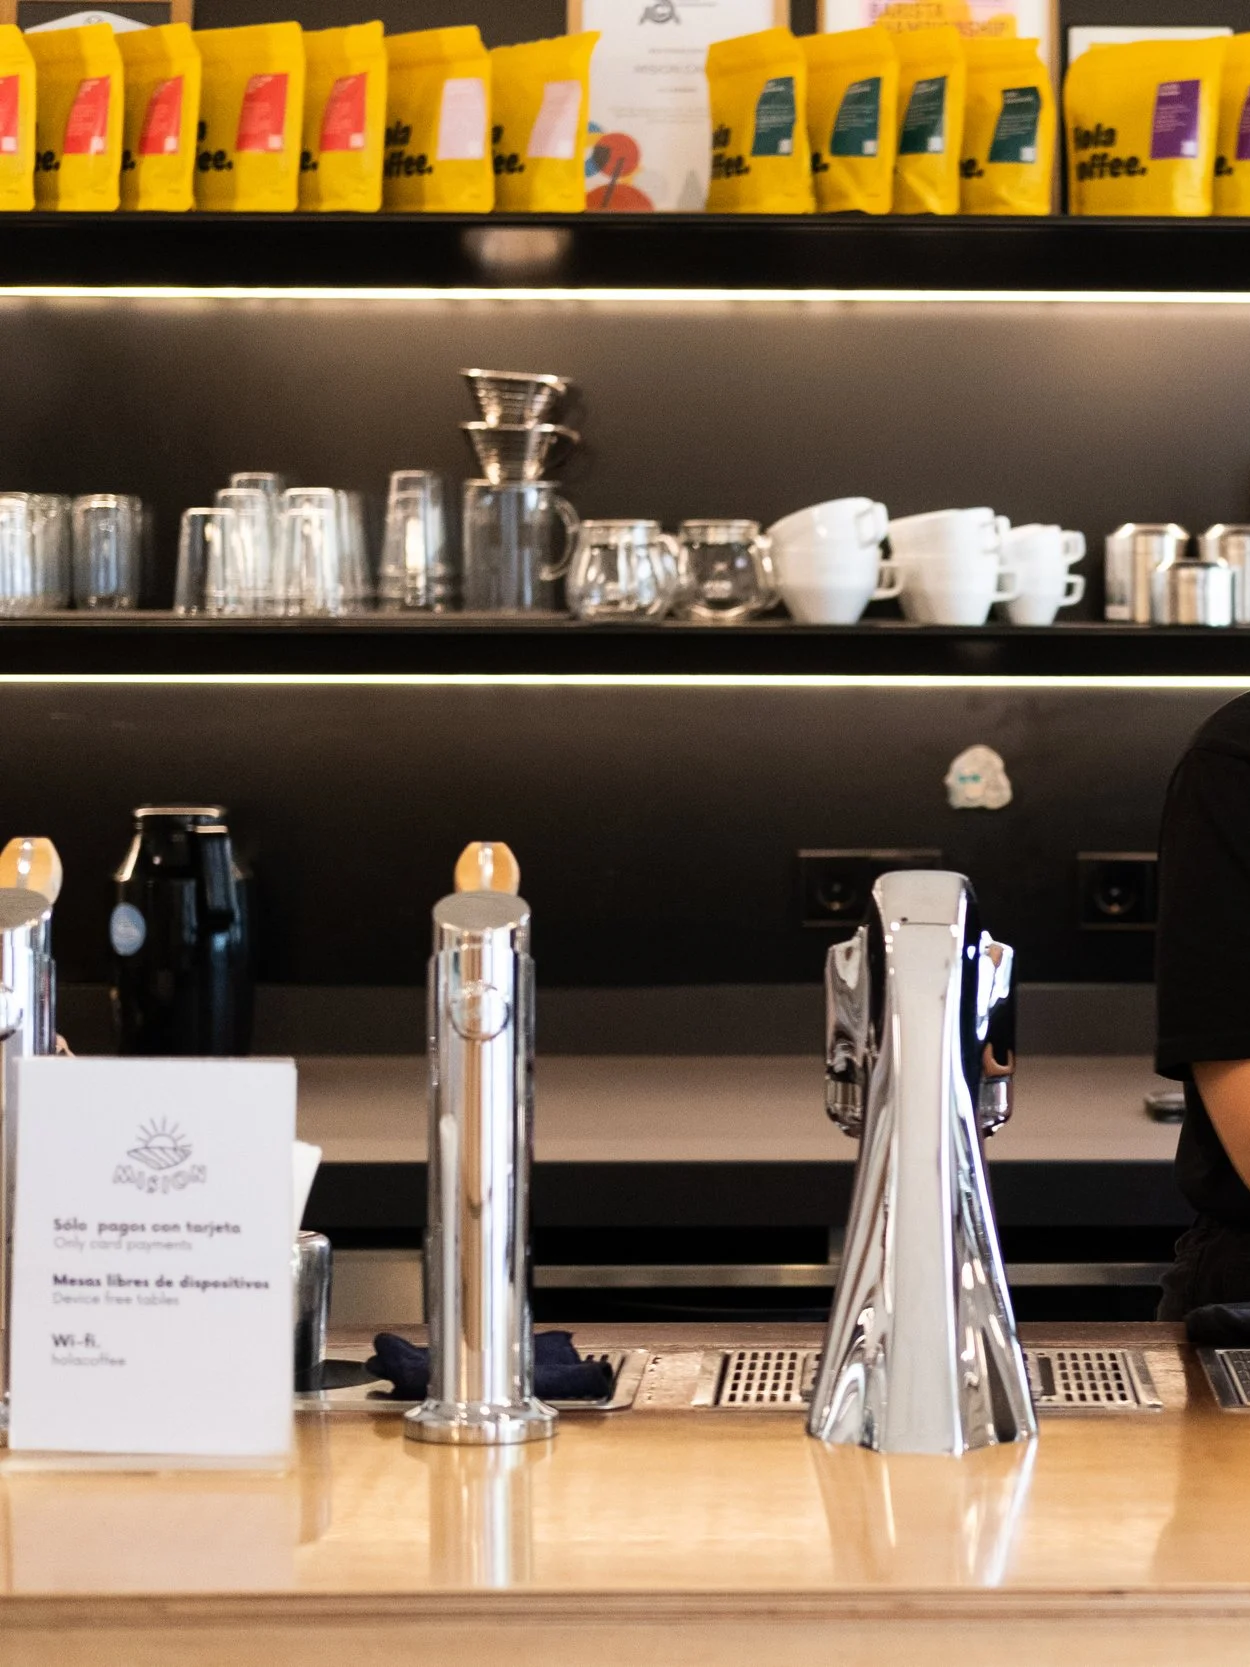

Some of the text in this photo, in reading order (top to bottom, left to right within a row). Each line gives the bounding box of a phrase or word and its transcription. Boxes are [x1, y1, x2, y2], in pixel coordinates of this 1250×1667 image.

[111, 1164, 208, 1195] MISION
[97, 1222, 147, 1237] pagos
[151, 1222, 181, 1233] con
[186, 1221, 242, 1238] tarjeta
[53, 1236, 193, 1253] Only card payments
[52, 1273, 270, 1293] Mesas libres de dispositivos
[52, 1291, 180, 1306] Device free tables
[50, 1354, 127, 1367] holacoffee
